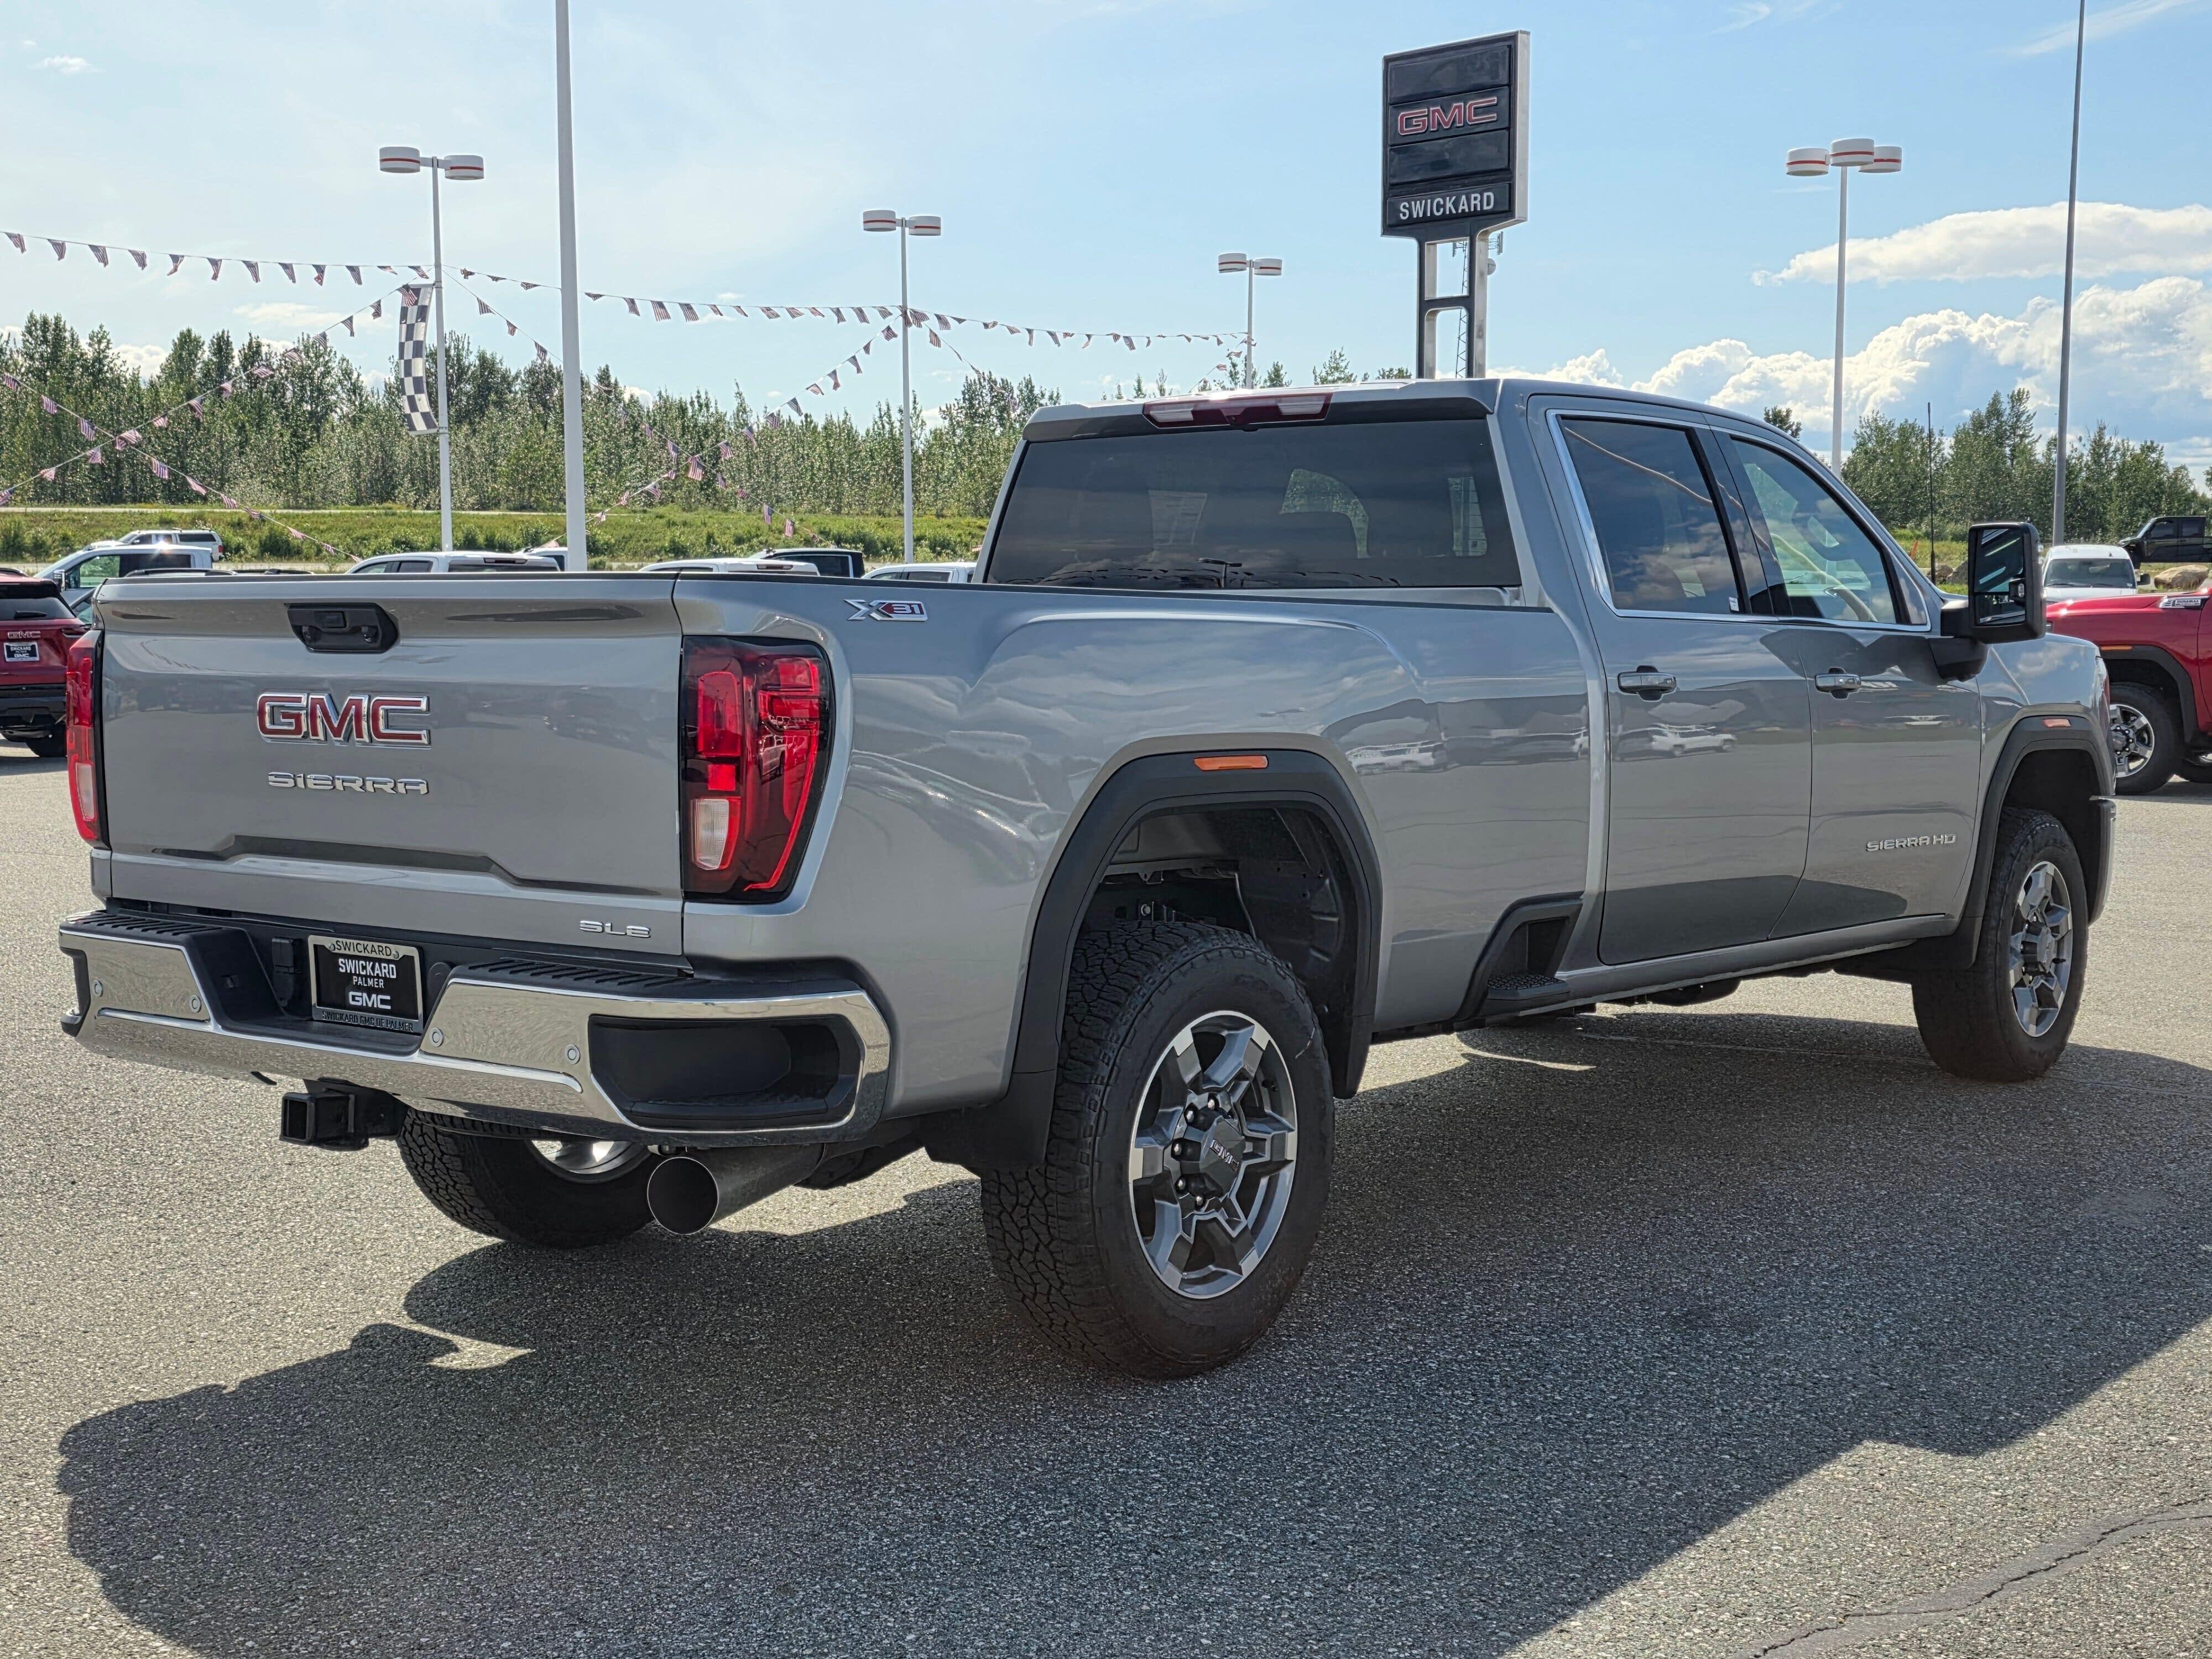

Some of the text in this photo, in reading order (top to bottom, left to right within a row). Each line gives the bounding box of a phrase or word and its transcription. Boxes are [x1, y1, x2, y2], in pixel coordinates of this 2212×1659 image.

[1398, 97, 1498, 135] GMC
[1400, 192, 1494, 220] SWICKARD
[8, 630, 41, 639] GMC
[257, 692, 431, 747] GMC
[268, 772, 429, 795] SIERRA
[1866, 834, 1956, 852] SIERRA HD
[580, 920, 651, 938] SLE
[336, 940, 392, 957] SWICKARD
[338, 958, 397, 979] SWICKARD
[353, 975, 384, 989] PALMER
[348, 991, 391, 1010] GMC
[322, 1011, 358, 1024] SWICKARD
[387, 1019, 414, 1032] PALMER
[1210, 1140, 1239, 1171] GMC
